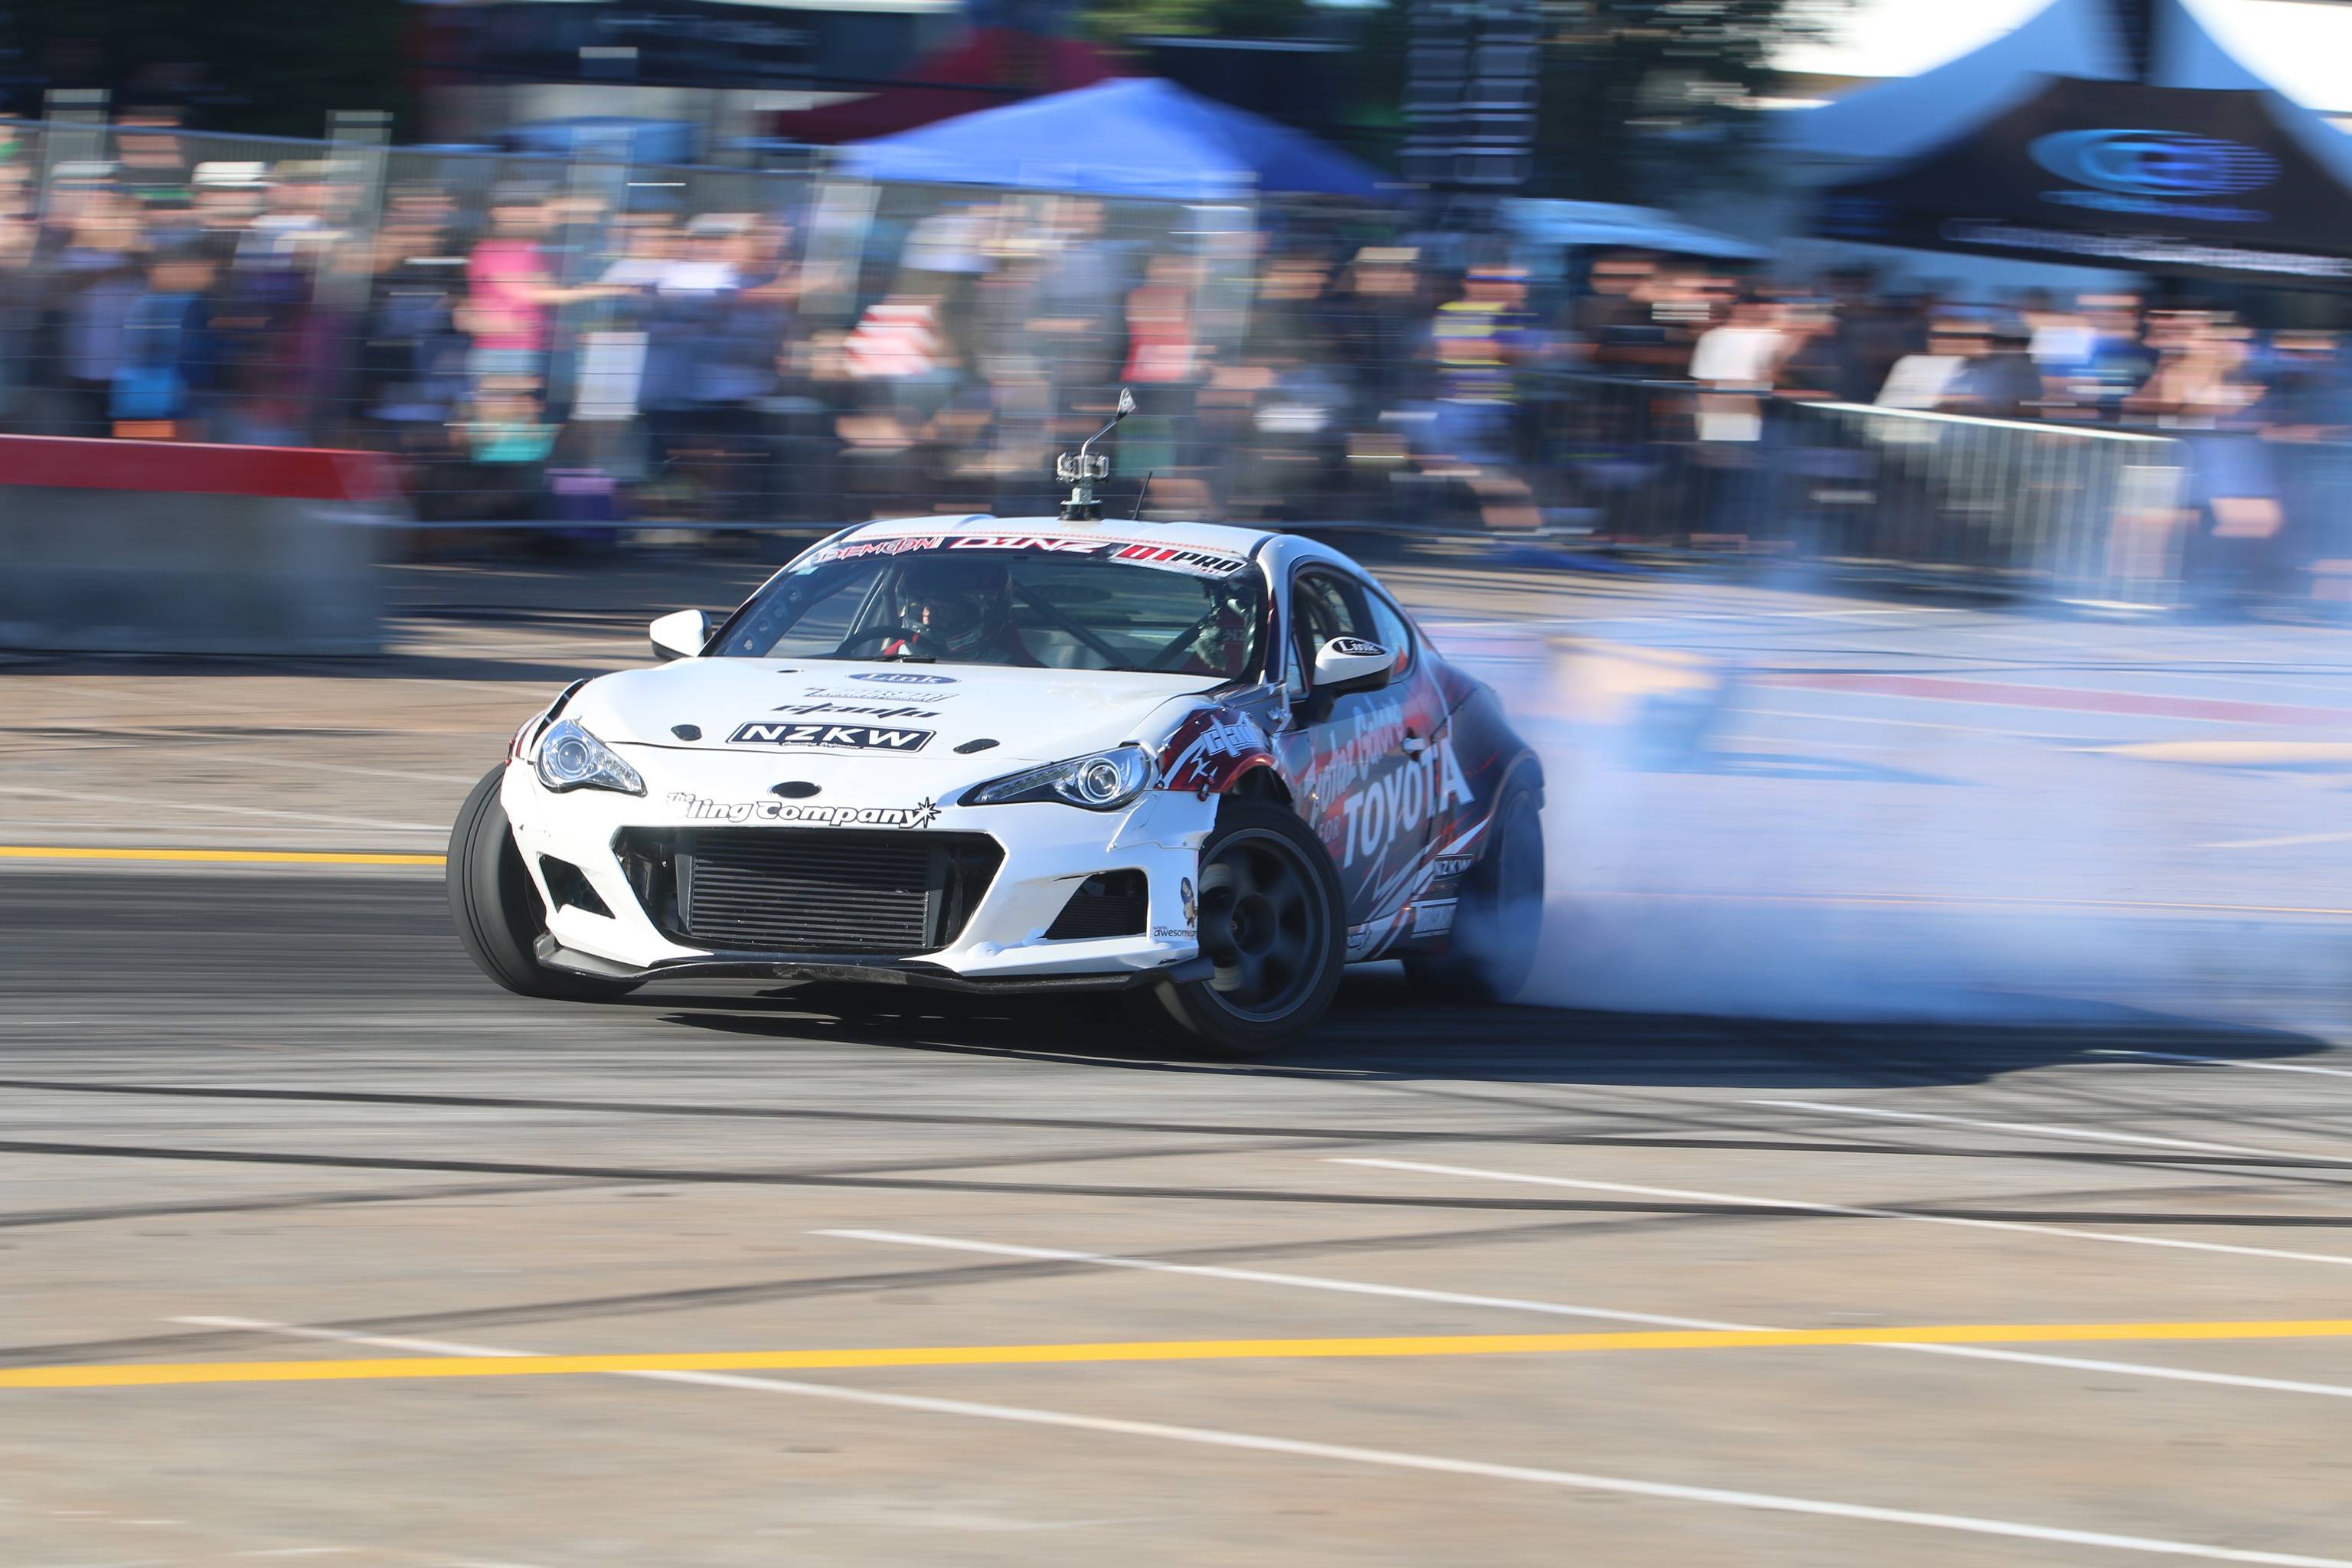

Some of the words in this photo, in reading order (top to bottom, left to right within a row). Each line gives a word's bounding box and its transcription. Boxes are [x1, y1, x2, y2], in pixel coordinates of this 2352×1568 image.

[740, 725, 922, 747] NZKW
[756, 801, 921, 829] Company
[1343, 737, 1476, 870] TOYOTA
